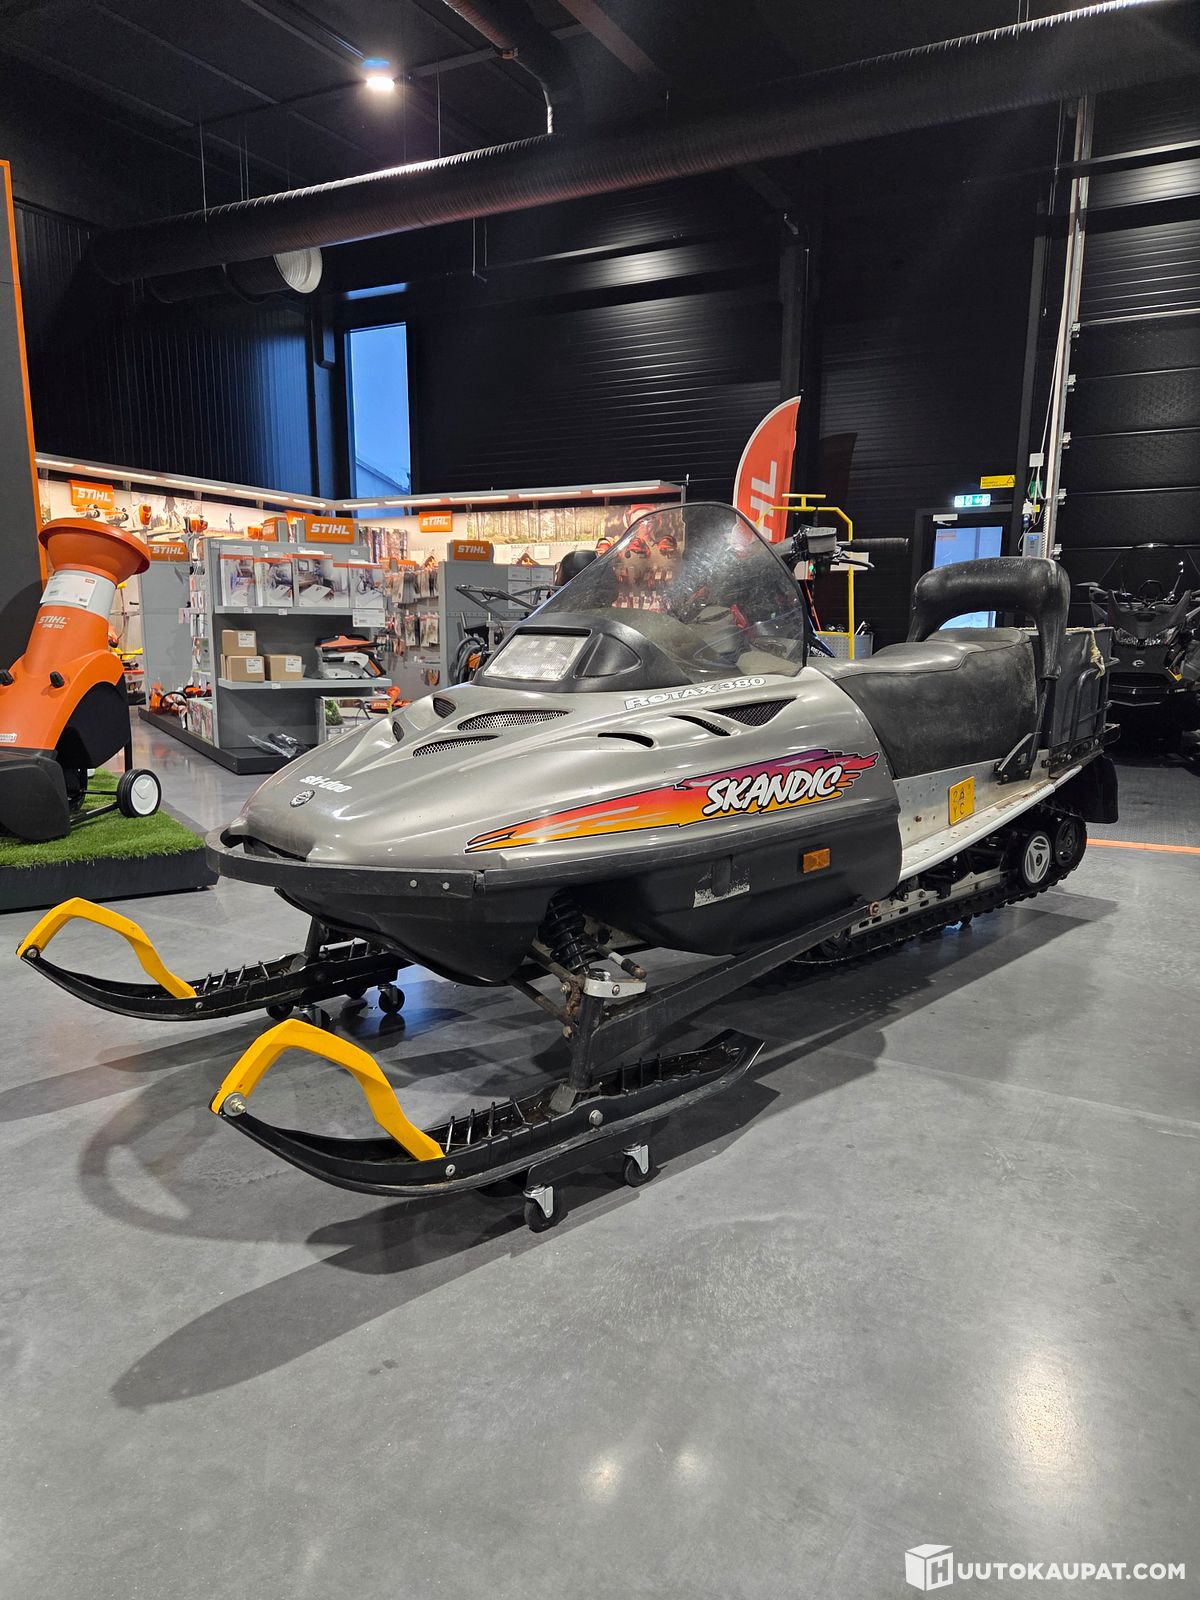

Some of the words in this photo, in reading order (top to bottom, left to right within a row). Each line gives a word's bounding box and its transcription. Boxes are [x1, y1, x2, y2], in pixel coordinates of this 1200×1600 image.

[77, 488, 112, 502] STIHL
[422, 515, 449, 526] STIHL
[310, 522, 350, 535] STIHL
[152, 545, 184, 555] STIHL
[457, 545, 486, 555] STIHL
[38, 615, 68, 625] STIHL
[624, 684, 719, 710] ROTAX
[719, 677, 766, 691] 380
[702, 764, 843, 816] SKANDIC
